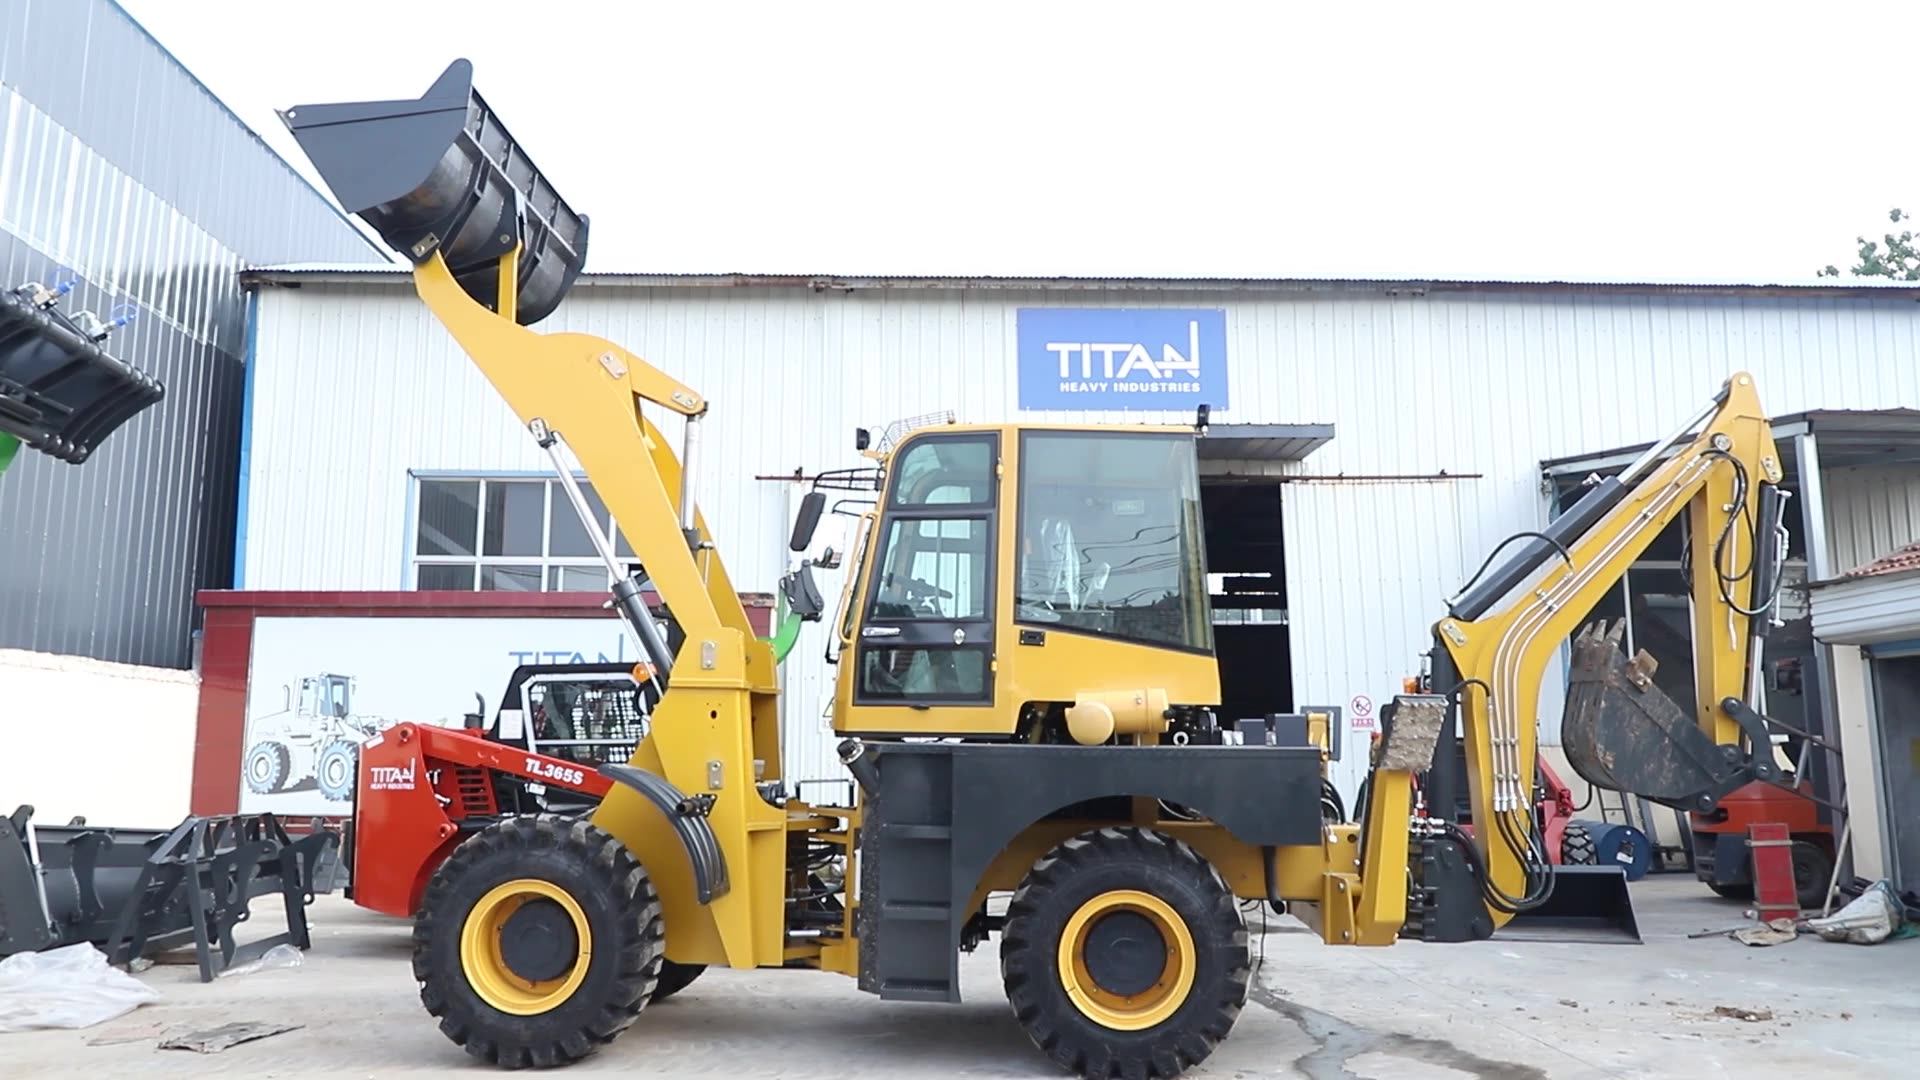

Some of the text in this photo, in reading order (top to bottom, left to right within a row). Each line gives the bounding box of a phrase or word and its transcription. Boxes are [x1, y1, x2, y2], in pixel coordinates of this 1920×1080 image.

[1046, 320, 1200, 379] TITAN
[1060, 382, 1201, 393] HEAVY INDUSTRIES
[370, 757, 416, 783] TITAN
[524, 758, 585, 785] TL365S
